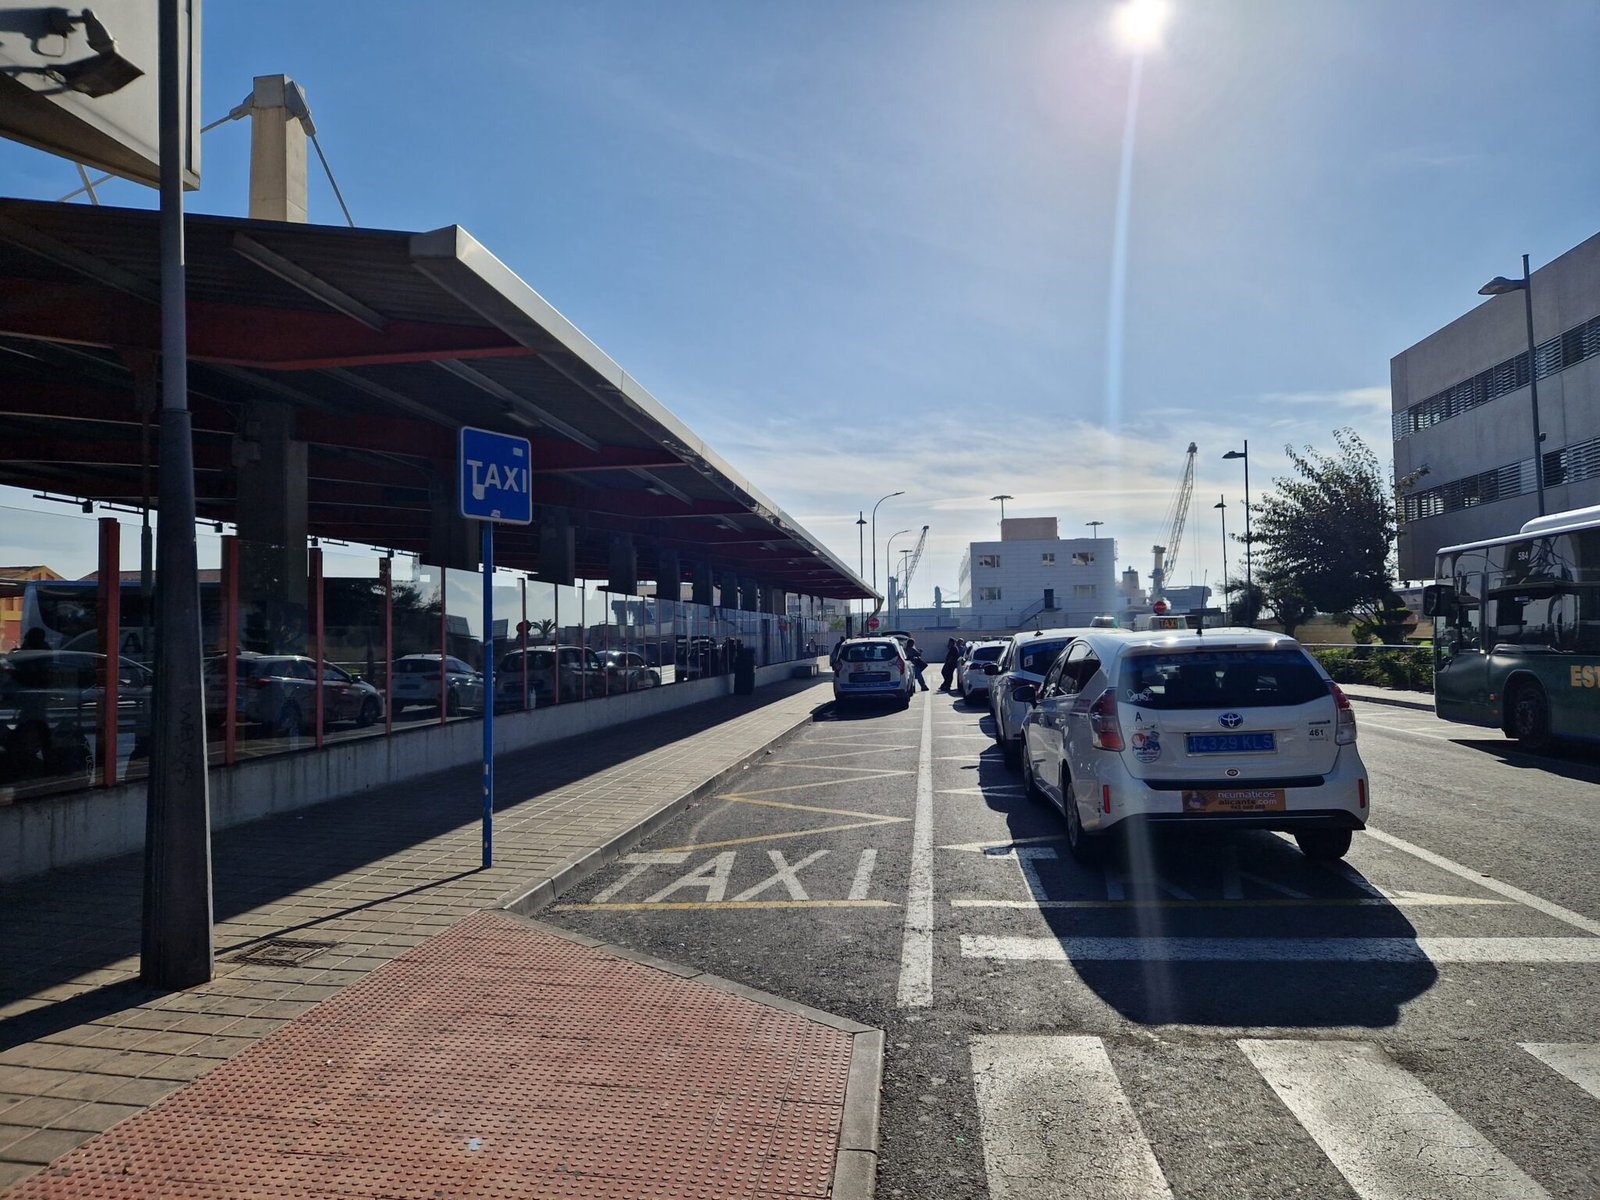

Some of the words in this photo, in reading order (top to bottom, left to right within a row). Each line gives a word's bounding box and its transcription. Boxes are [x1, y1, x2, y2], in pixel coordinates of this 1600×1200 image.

[466, 459, 527, 493] TAXI
[1518, 551, 1529, 560] 584
[1159, 618, 1178, 629] TAXI
[1135, 712, 1143, 722] A
[1309, 728, 1324, 737] 461
[1199, 736, 1238, 751] 4329
[1243, 734, 1273, 749] KLS
[590, 848, 877, 902] TAXI
